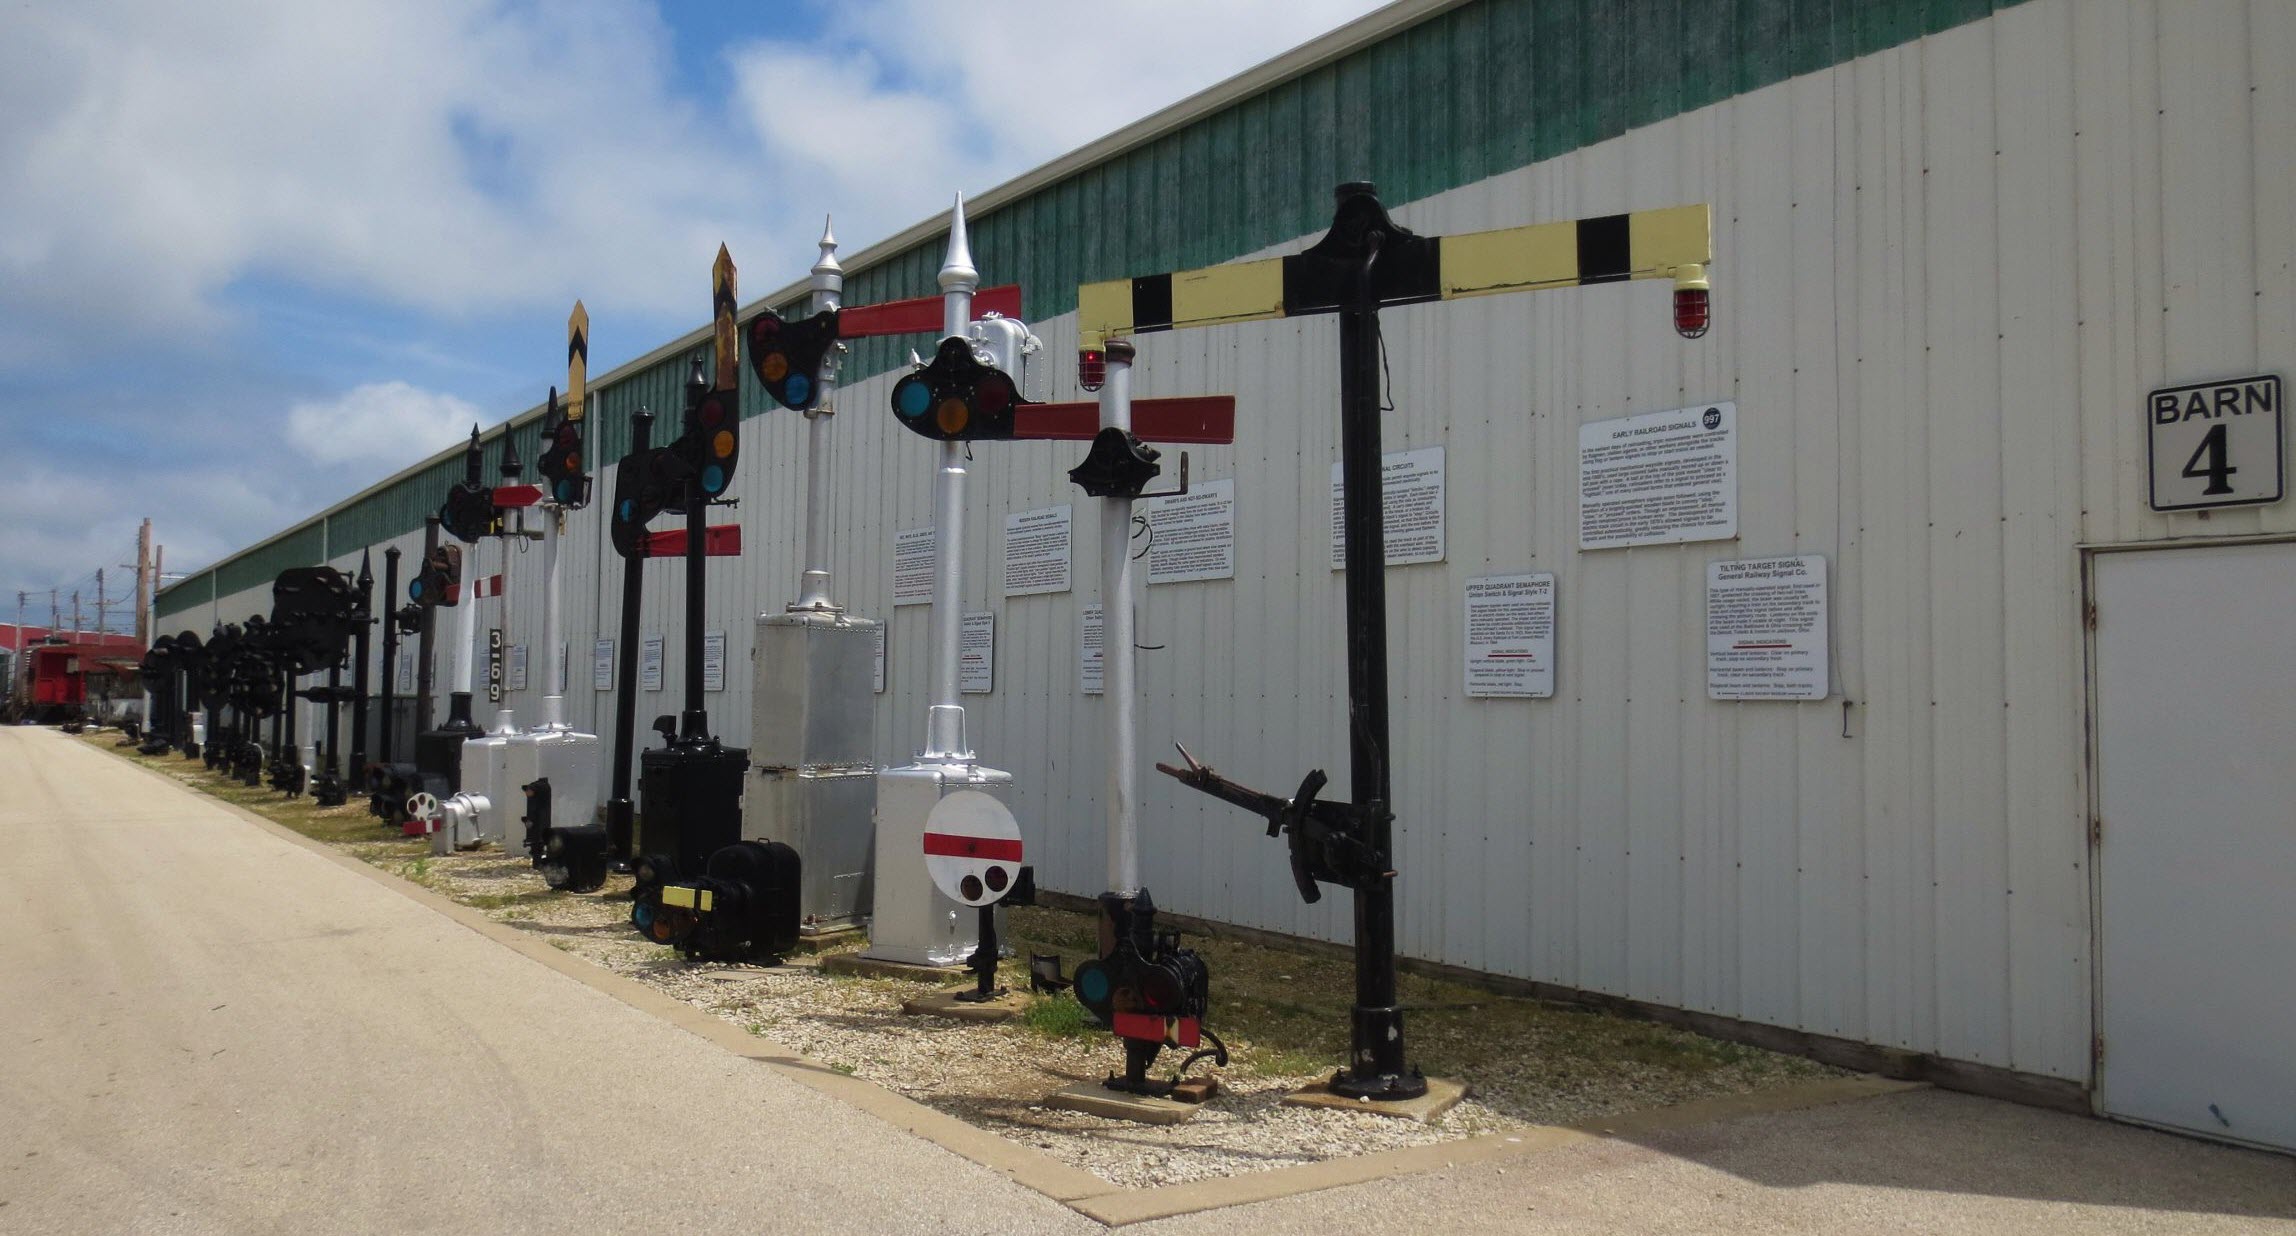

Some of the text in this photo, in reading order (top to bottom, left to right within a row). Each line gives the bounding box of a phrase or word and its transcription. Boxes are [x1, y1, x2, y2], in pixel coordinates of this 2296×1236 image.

[2155, 382, 2272, 425] BARN
[1704, 413, 1719, 425] 997
[1612, 421, 1697, 439] EARLY RAILROAD SIGNALS
[2182, 423, 2237, 496] 4
[1392, 462, 1414, 471] CIRCUITS
[1719, 560, 1805, 572] TILTING TARGET SIGNAL
[1718, 568, 1808, 581] General Railway Signal Co.
[1466, 580, 1550, 592] UPPER QUADRANT SEMAPHORE
[1524, 588, 1538, 597] Style
